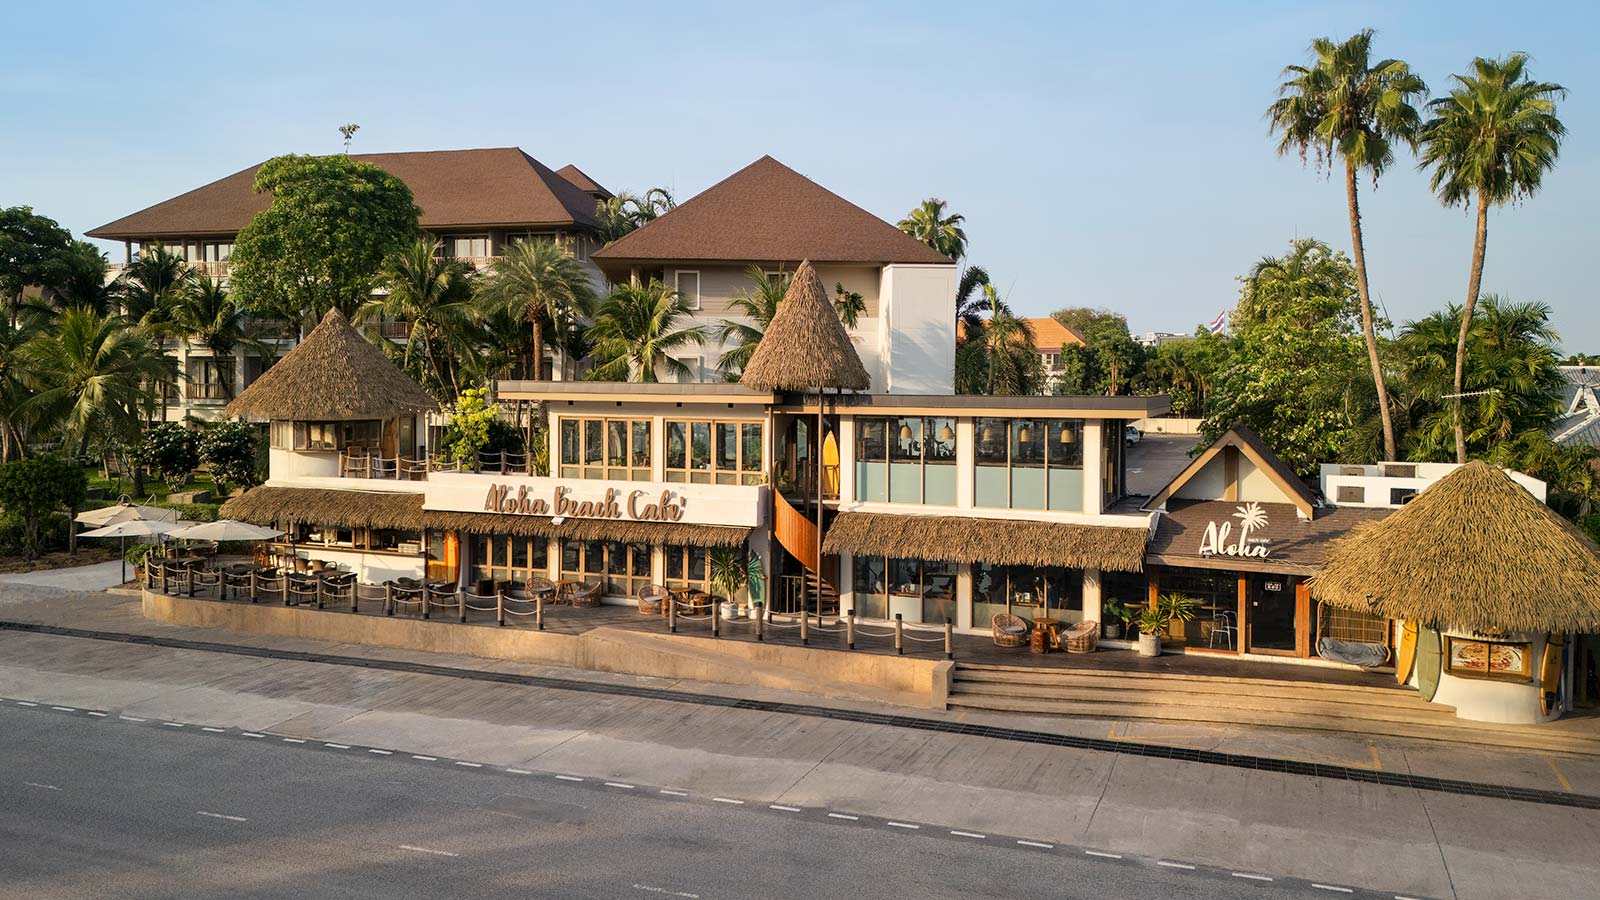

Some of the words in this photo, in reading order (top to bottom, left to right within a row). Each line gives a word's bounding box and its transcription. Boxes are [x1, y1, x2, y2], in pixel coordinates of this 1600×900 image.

[485, 483, 549, 514] Aloha
[554, 486, 622, 518] Beach
[1198, 517, 1271, 558] Aloha
